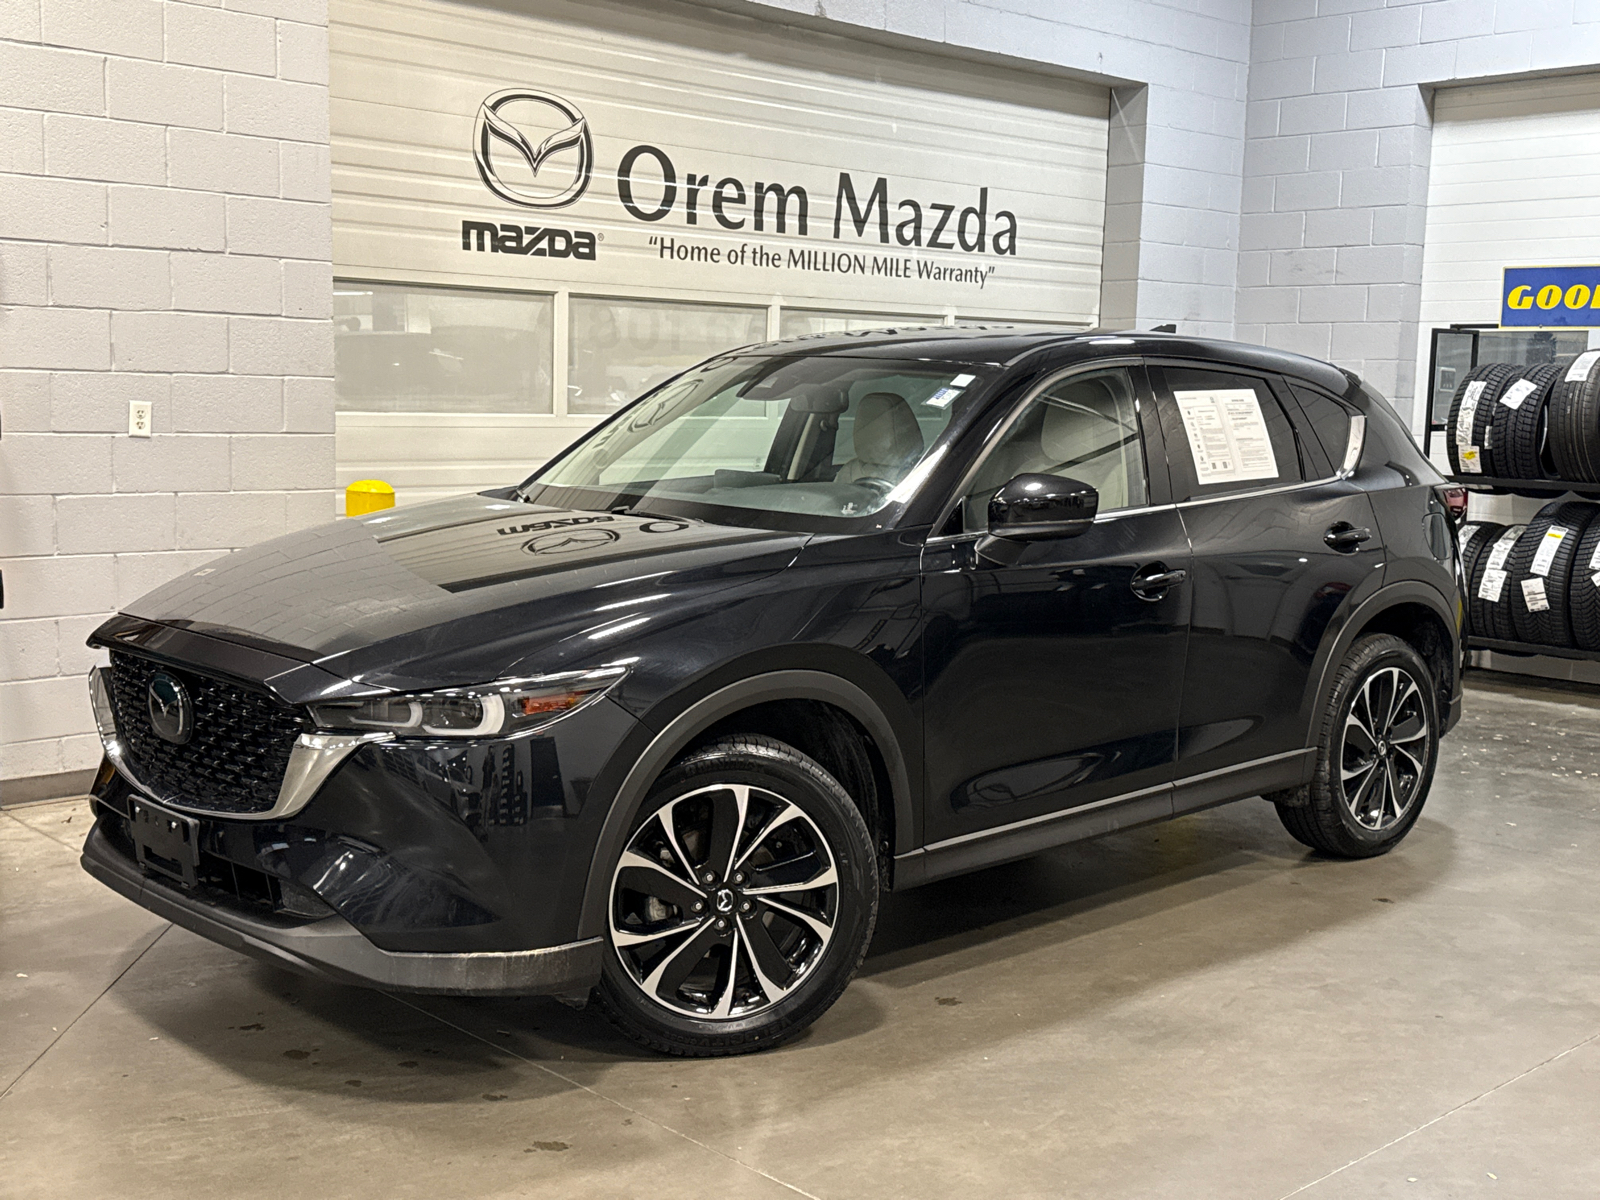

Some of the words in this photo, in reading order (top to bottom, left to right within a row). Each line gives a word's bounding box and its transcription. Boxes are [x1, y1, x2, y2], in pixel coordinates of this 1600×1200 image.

[617, 144, 809, 236] Orem
[833, 172, 1017, 256] Mazda
[727, 243, 748, 265] of
[752, 245, 782, 268] the
[787, 249, 866, 275] MILLION
[871, 256, 912, 278] MILE
